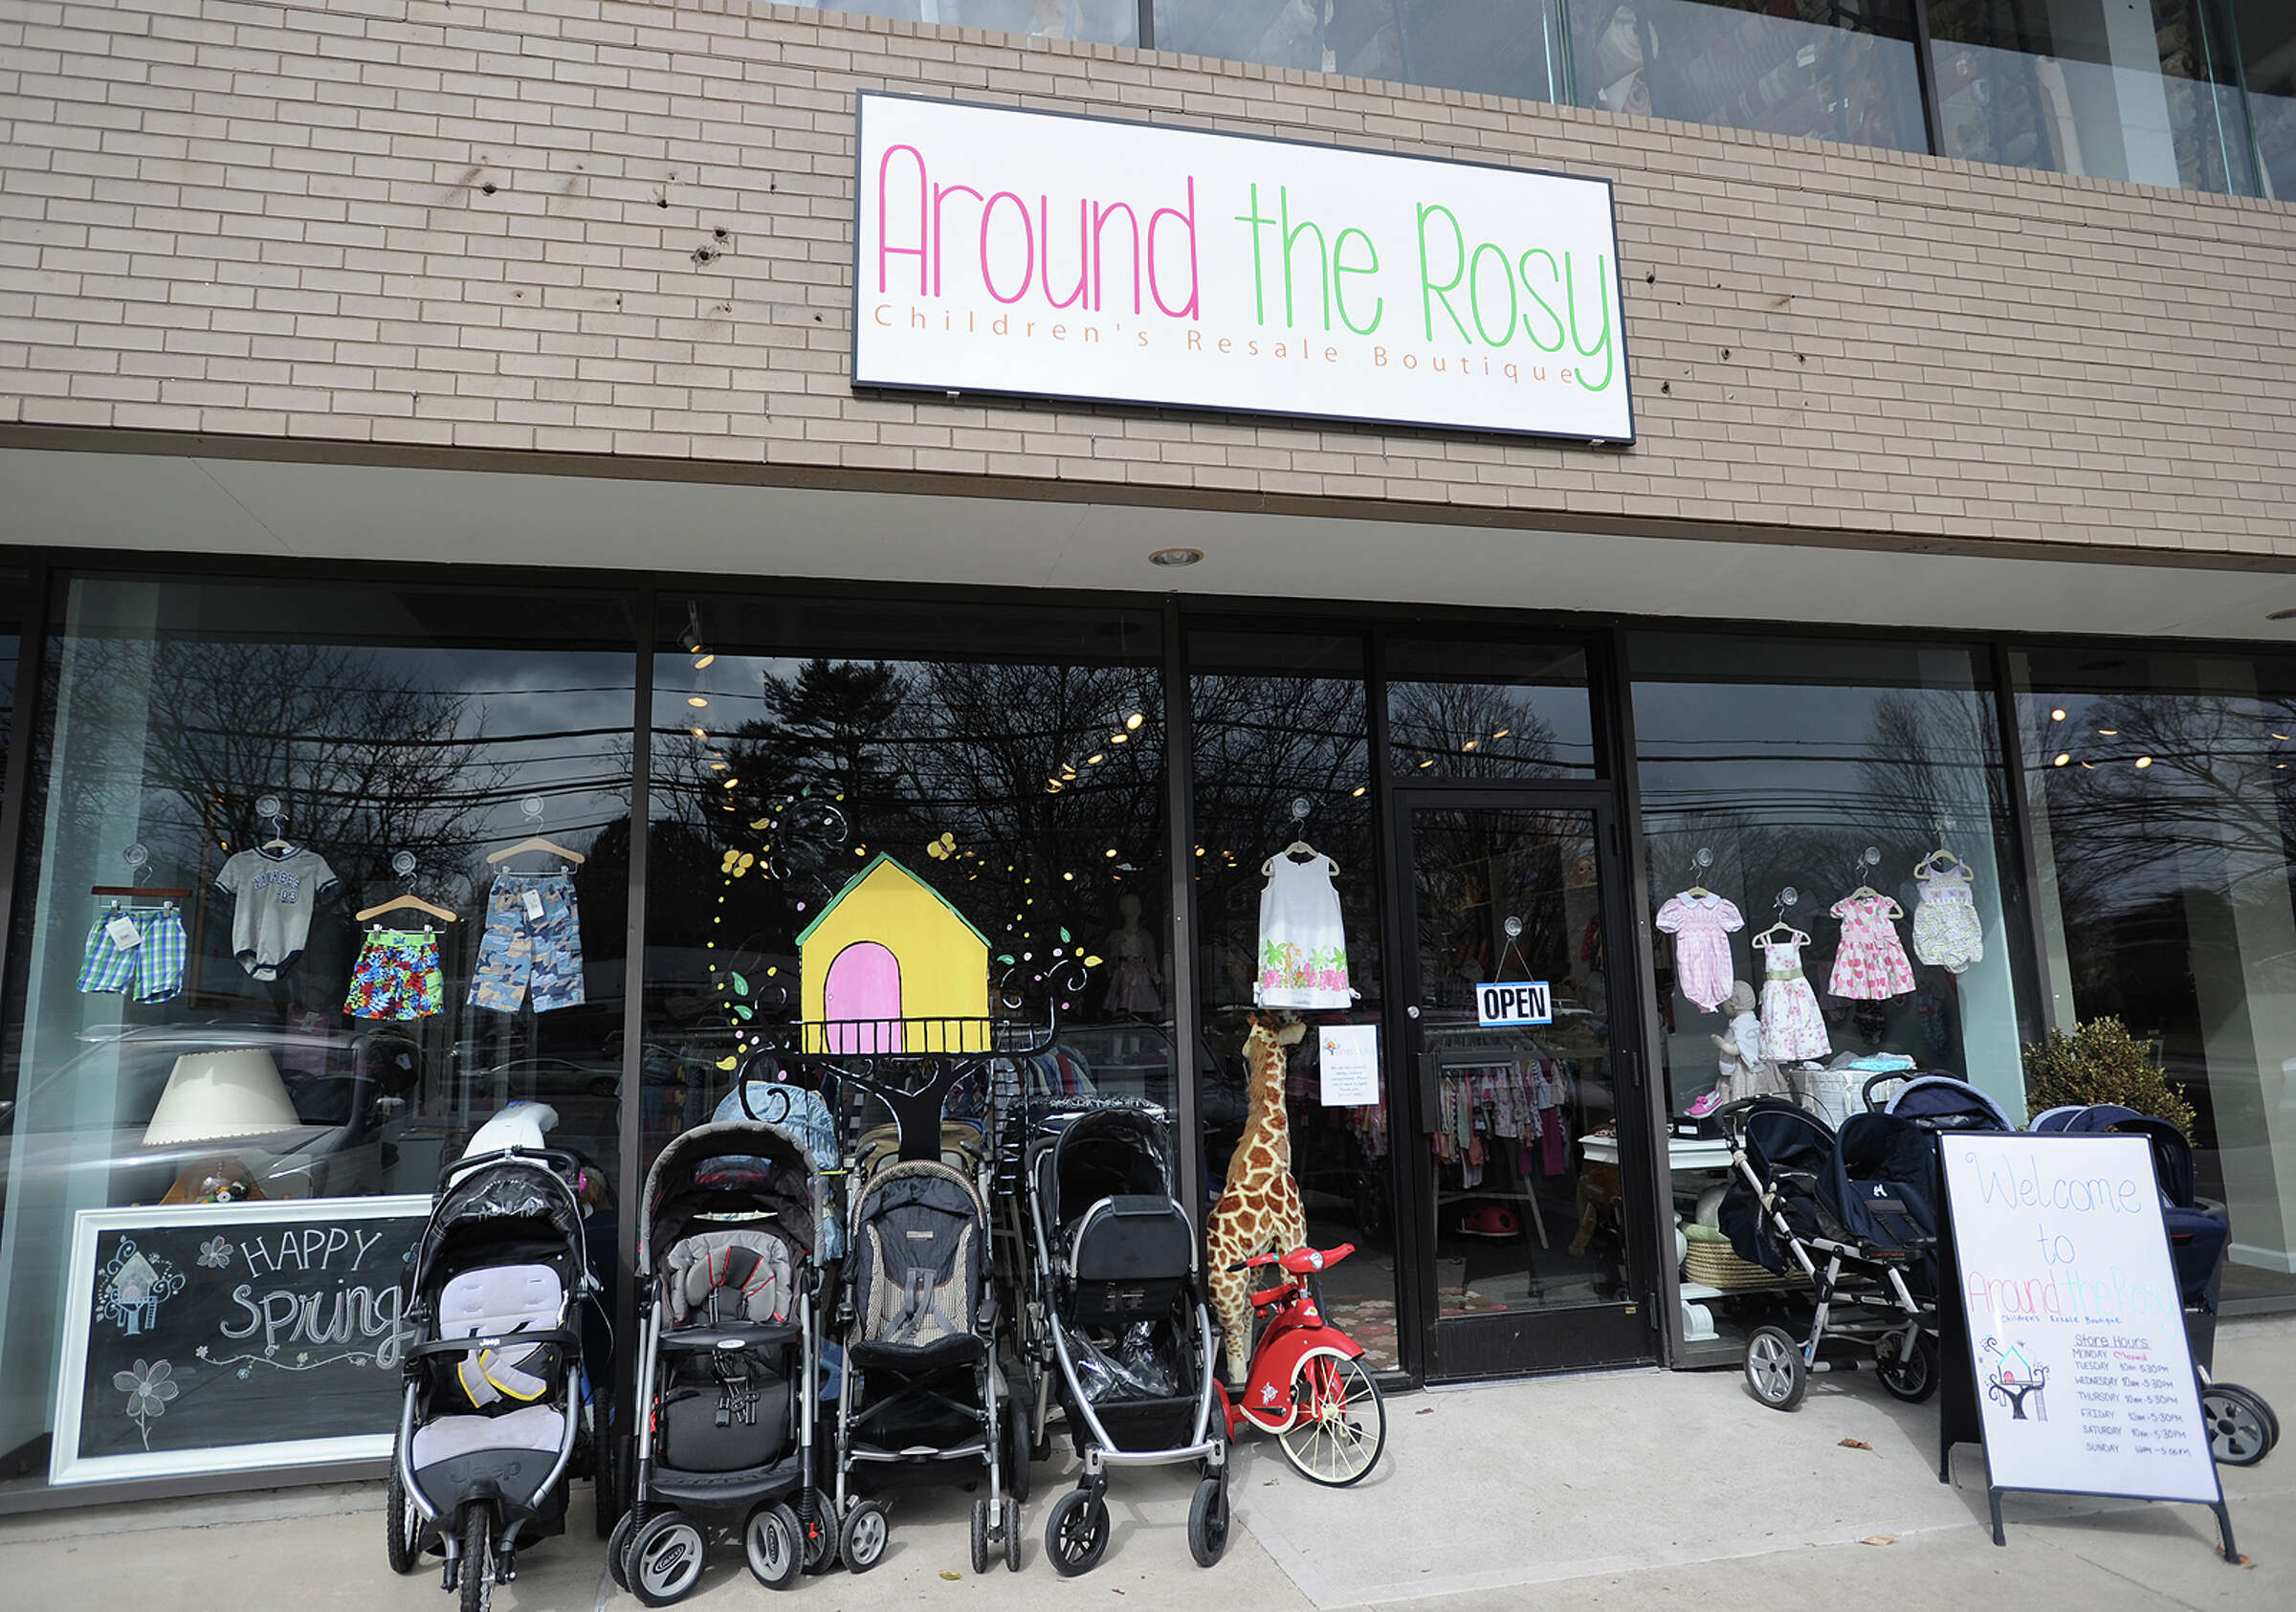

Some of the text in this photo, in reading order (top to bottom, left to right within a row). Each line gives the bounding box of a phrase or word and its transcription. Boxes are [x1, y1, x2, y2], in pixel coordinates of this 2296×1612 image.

[879, 144, 1613, 392] Around the Rosy
[874, 304, 1575, 385] Children's Resale Boutique
[1483, 987, 1547, 1021] OPEN
[1966, 1151, 2142, 1214] Welcome
[2037, 1224, 2075, 1265] to
[239, 1227, 383, 1278] HAPPY
[1968, 1266, 2180, 1338] Around the Rosy
[219, 1278, 416, 1369] Spring
[479, 1338, 500, 1347] Jeep
[2075, 1334, 2150, 1349] Store Hours
[2072, 1348, 2108, 1359] MONDAY
[2074, 1361, 2109, 1371] TUESDAY
[2074, 1377, 2119, 1386] WEDNESDAY
[2078, 1391, 2121, 1402] THURSDAY
[2081, 1407, 2115, 1419] FRIDAY
[2083, 1424, 2122, 1435] SATURDAY
[2086, 1443, 2120, 1453] SUNDAY
